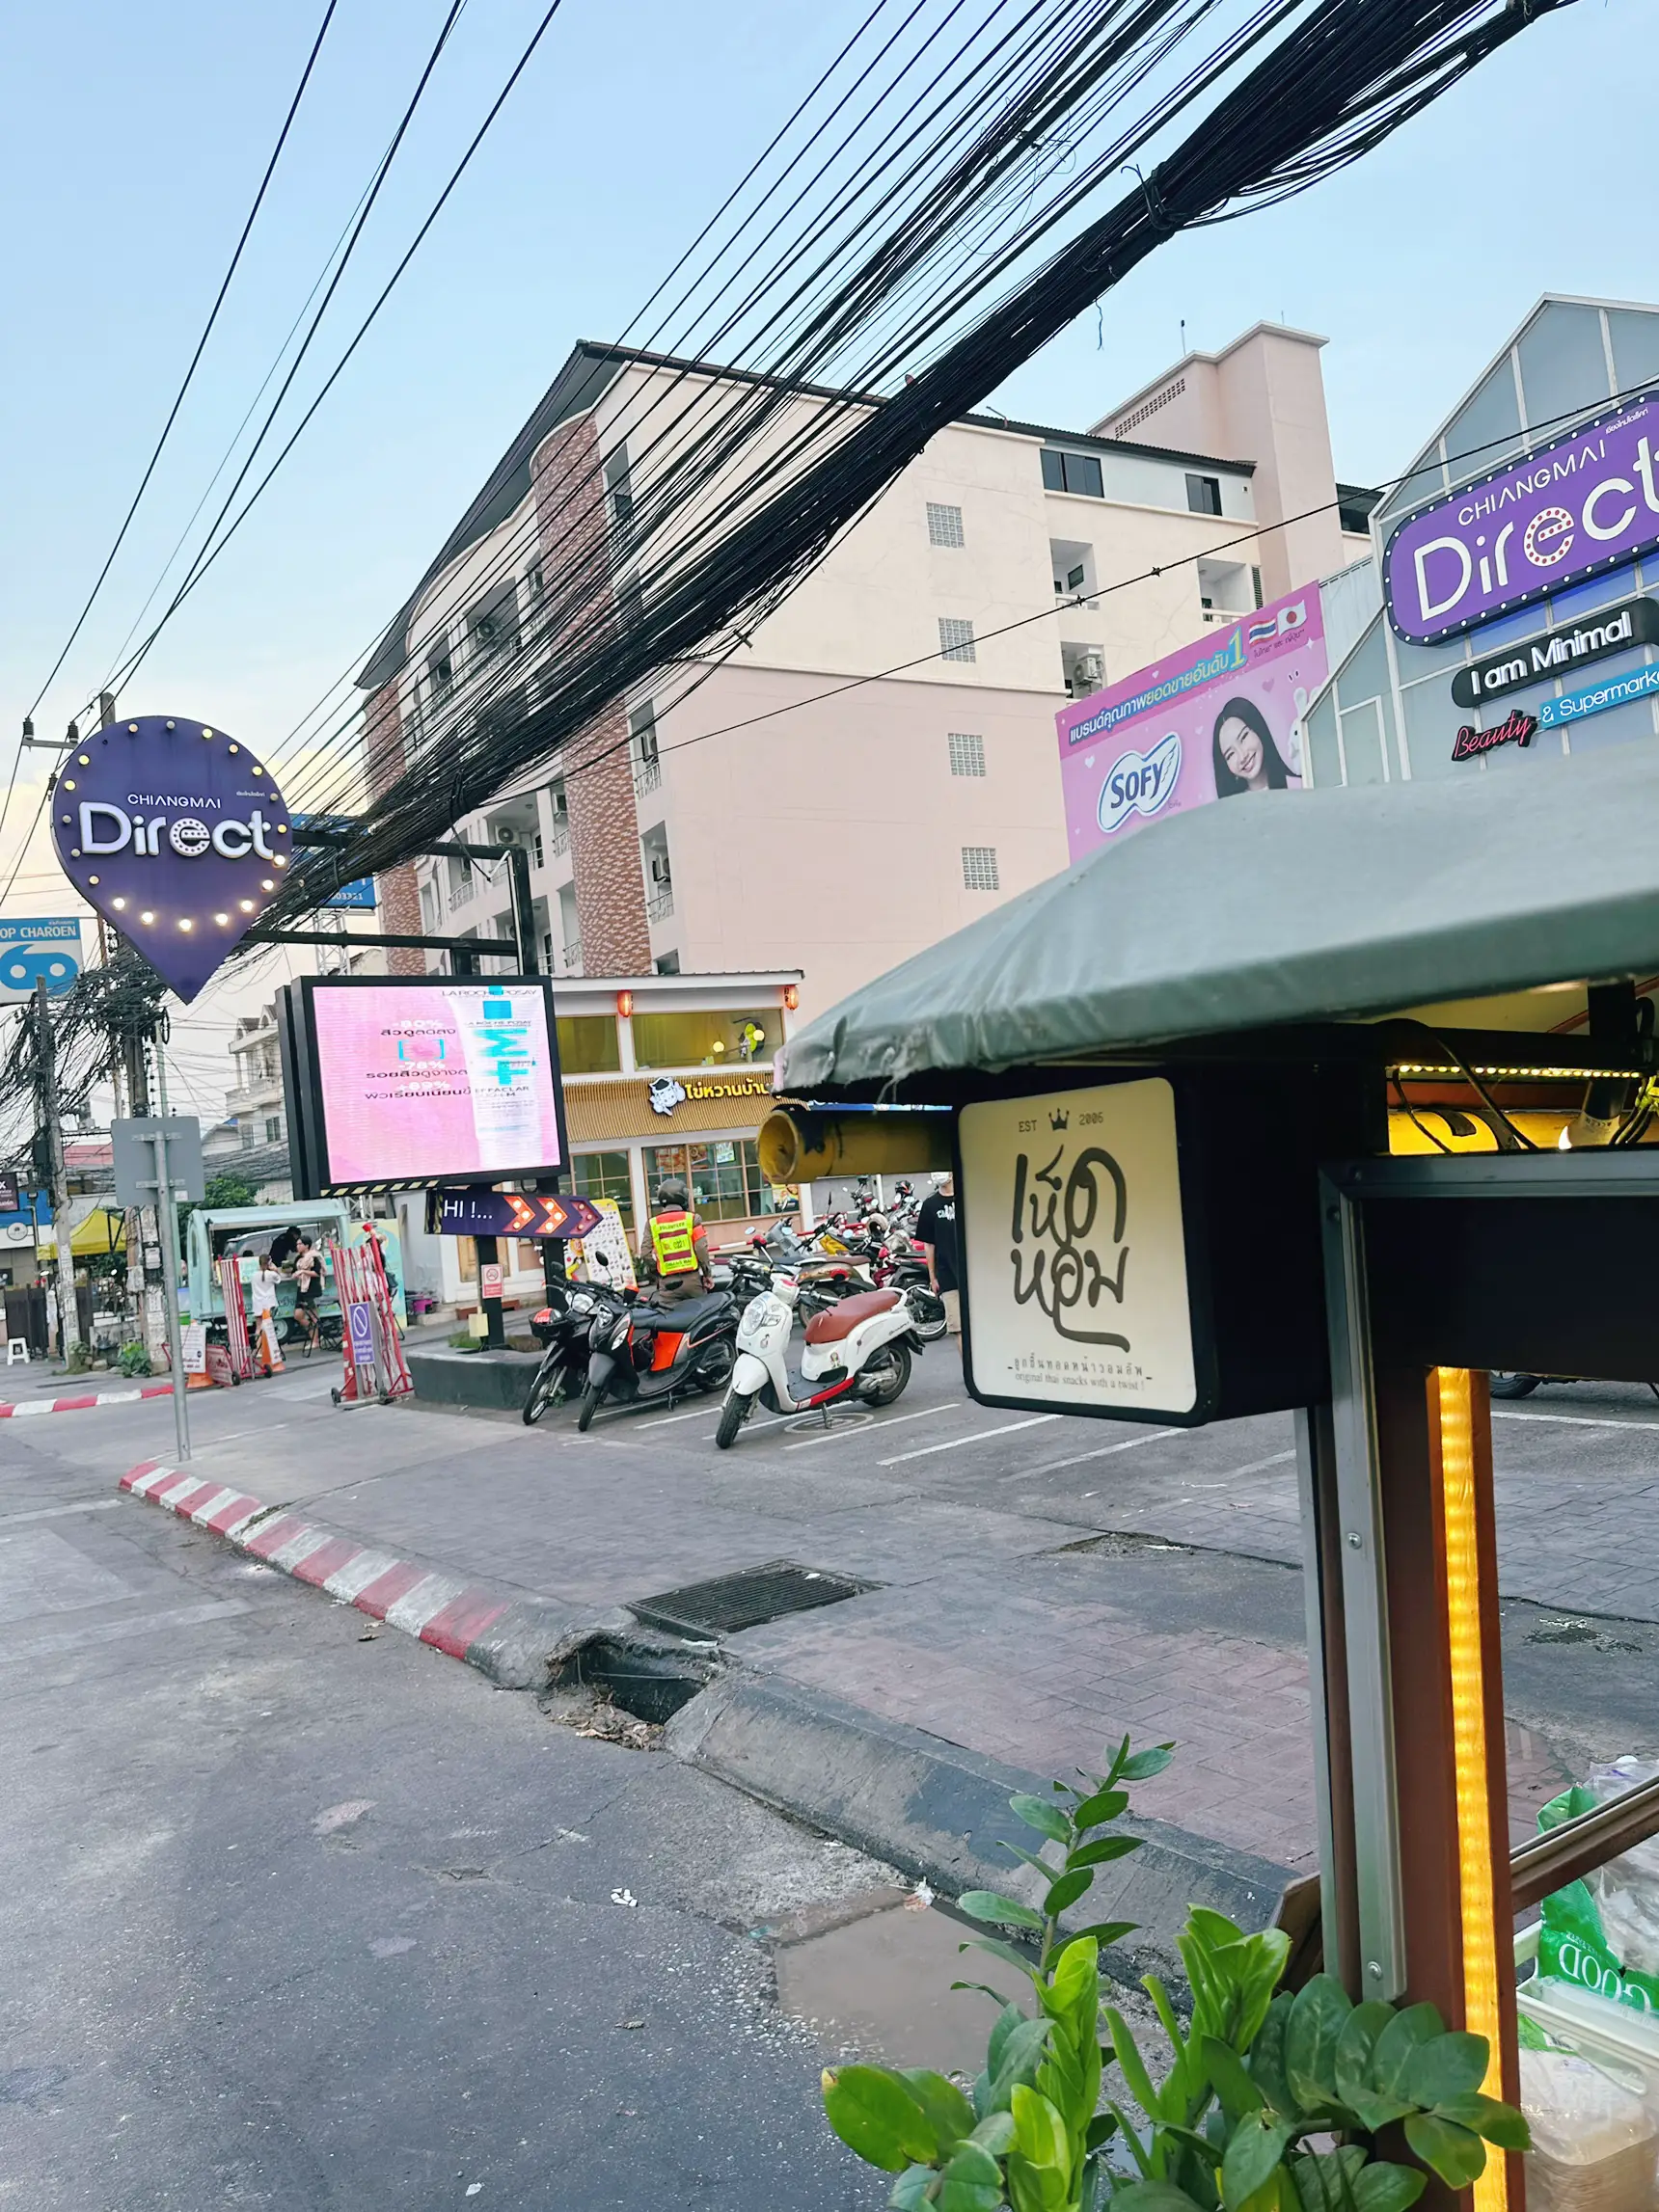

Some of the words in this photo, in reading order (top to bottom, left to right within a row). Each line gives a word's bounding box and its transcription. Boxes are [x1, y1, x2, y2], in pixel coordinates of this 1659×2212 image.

[1458, 440, 1606, 526] CHIANGMAI
[1414, 437, 1659, 621] Direct
[1471, 670, 1481, 695] I
[1484, 660, 1528, 688] am
[1531, 611, 1633, 672] Minimal
[1542, 706, 1554, 724] &
[1560, 671, 1659, 716] Supermark
[1455, 710, 1532, 759] Beauty
[127, 794, 221, 809] CHIANGMAI
[1111, 763, 1163, 809] SOFY
[79, 801, 274, 860] Direct
[0, 928, 16, 939] OP
[20, 926, 76, 938] CHAROEN
[1019, 1119, 1038, 1133] EST
[444, 1200, 464, 1218] HI
